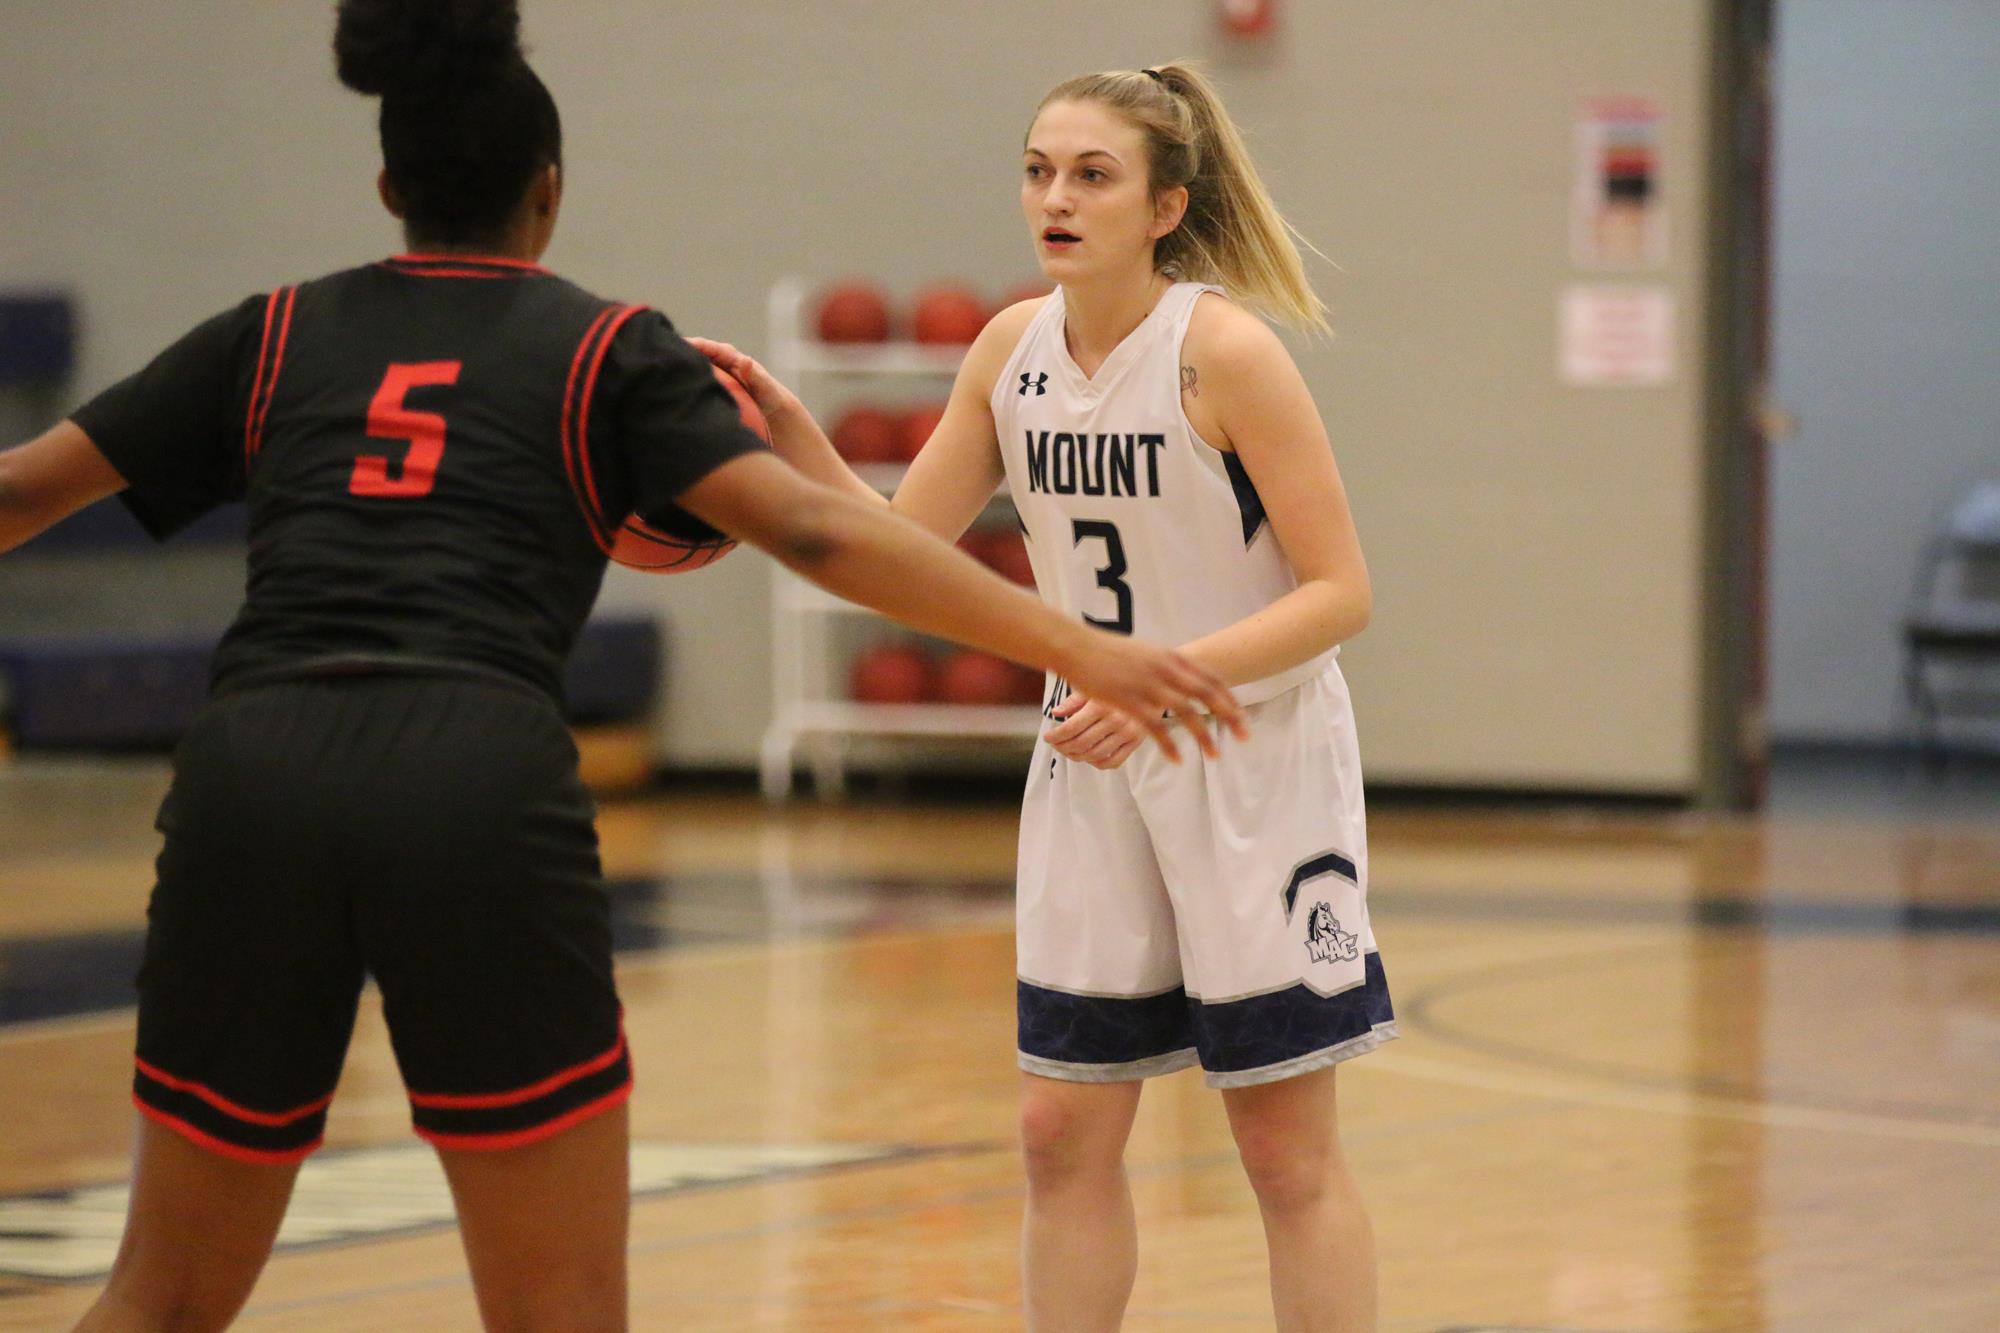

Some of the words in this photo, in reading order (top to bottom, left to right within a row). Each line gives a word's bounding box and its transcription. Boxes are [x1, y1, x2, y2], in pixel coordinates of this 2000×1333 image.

[348, 360, 462, 496] 5
[1025, 430, 1166, 498] MOUNT
[1070, 518, 1135, 637] 3
[1304, 934, 1359, 964] MAC
